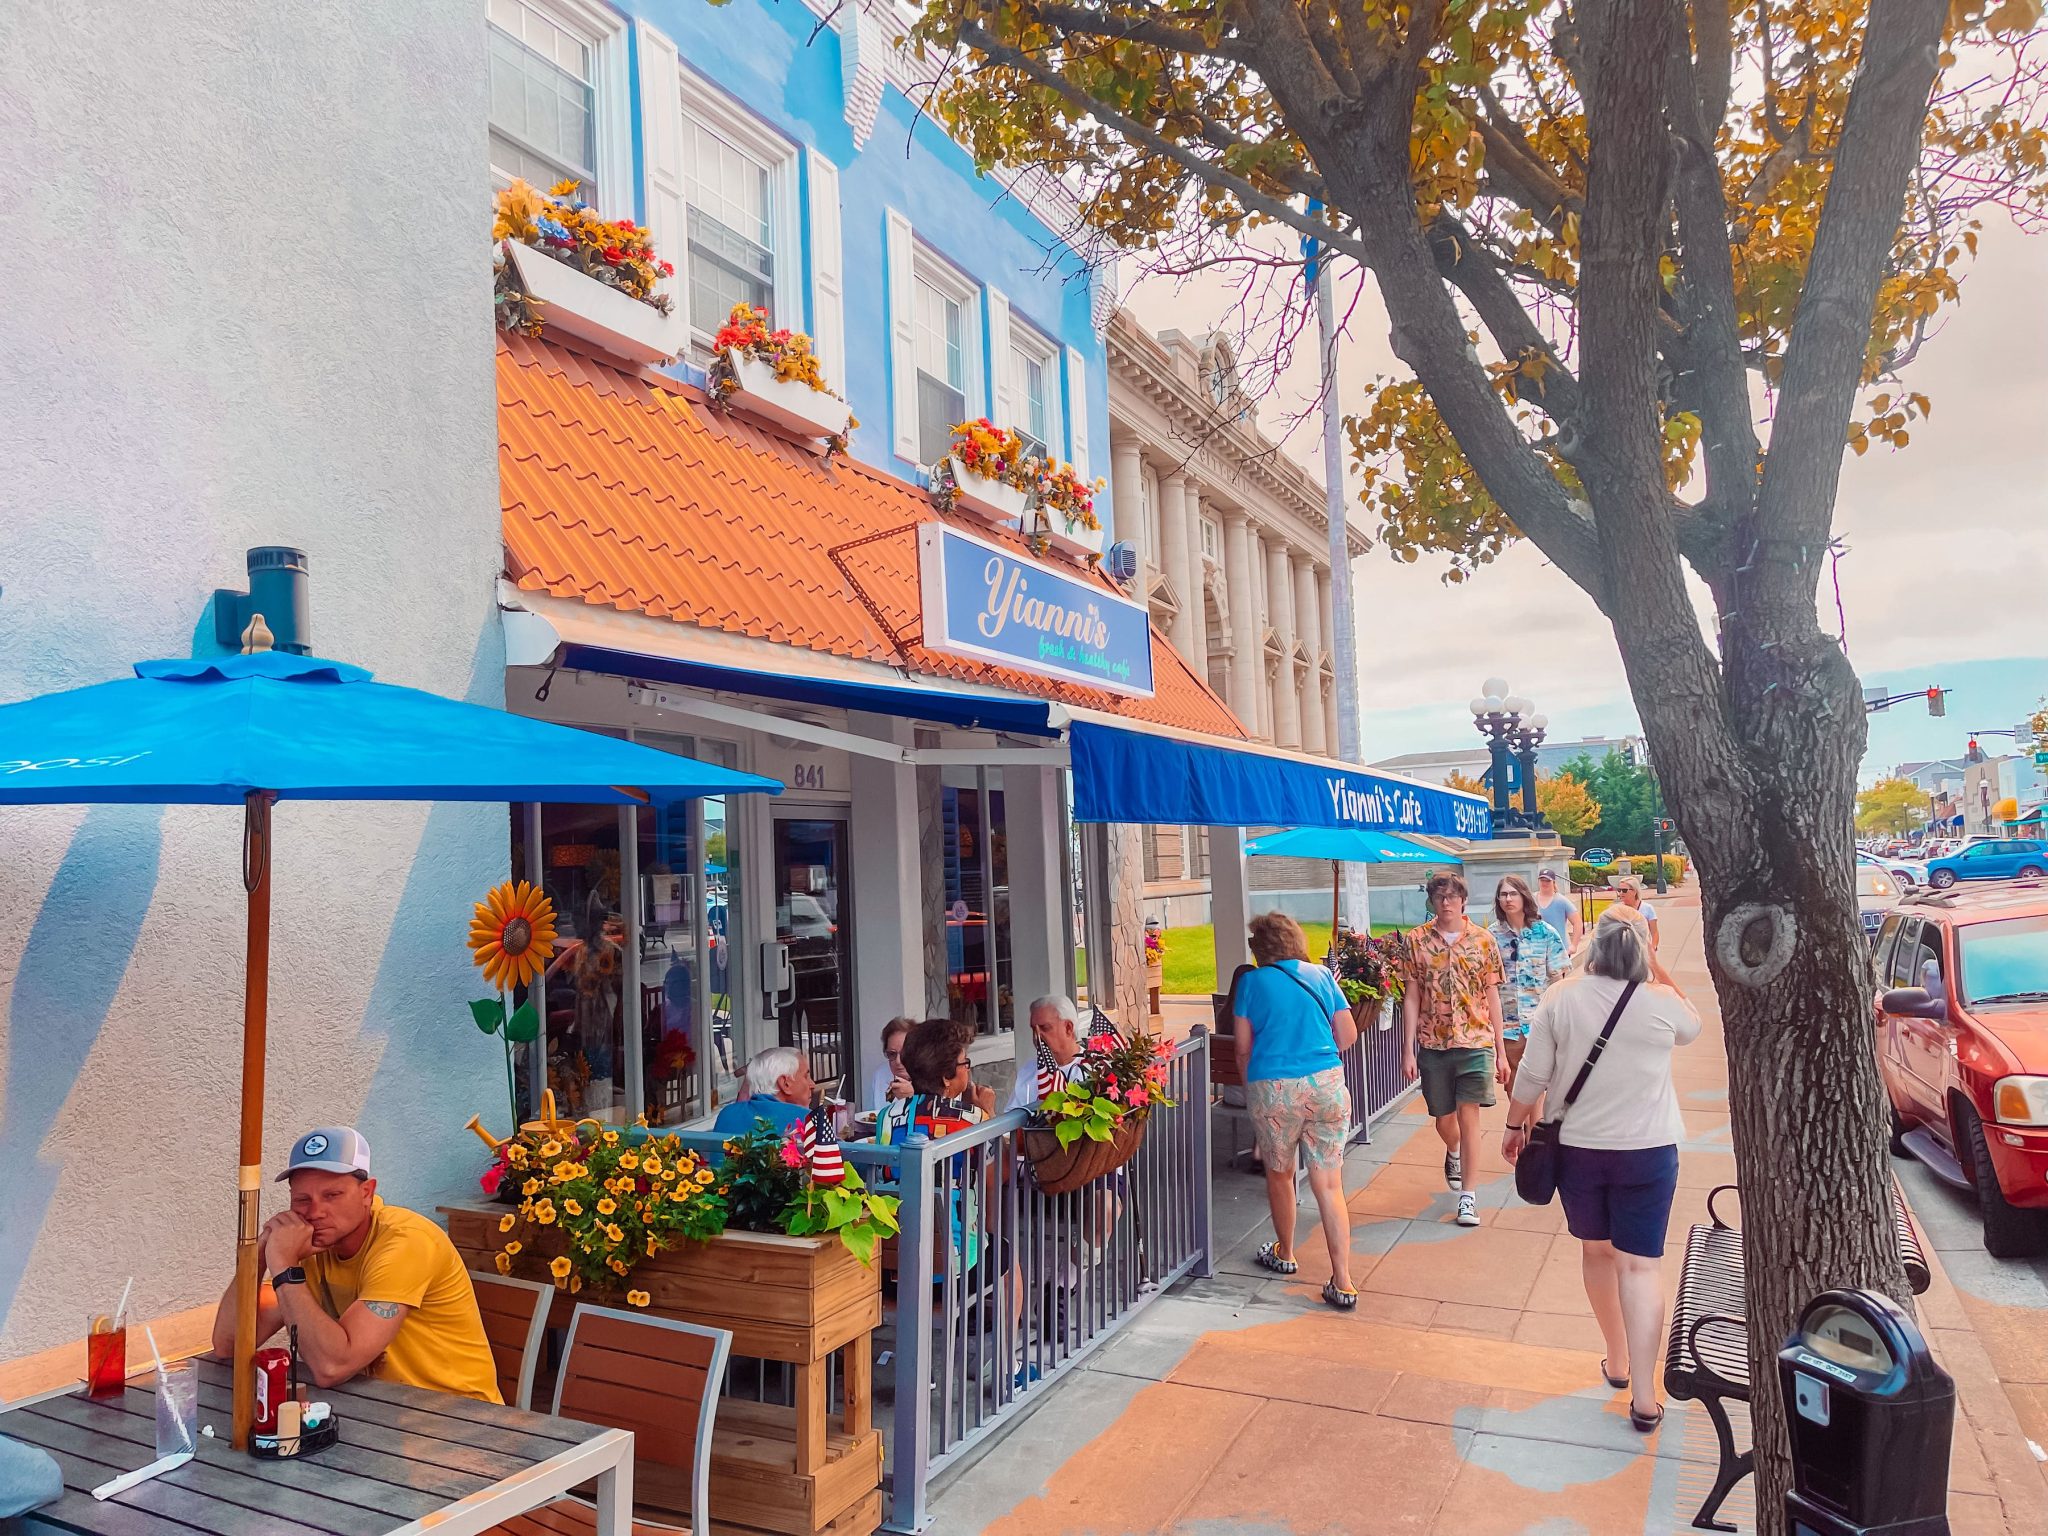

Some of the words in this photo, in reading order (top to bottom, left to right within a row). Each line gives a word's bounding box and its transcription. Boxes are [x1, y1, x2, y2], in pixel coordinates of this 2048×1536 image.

[978, 557, 1110, 650] Yianni's
[1067, 645, 1076, 661] &
[795, 764, 824, 788] 841
[1327, 778, 1395, 823] Yianni's
